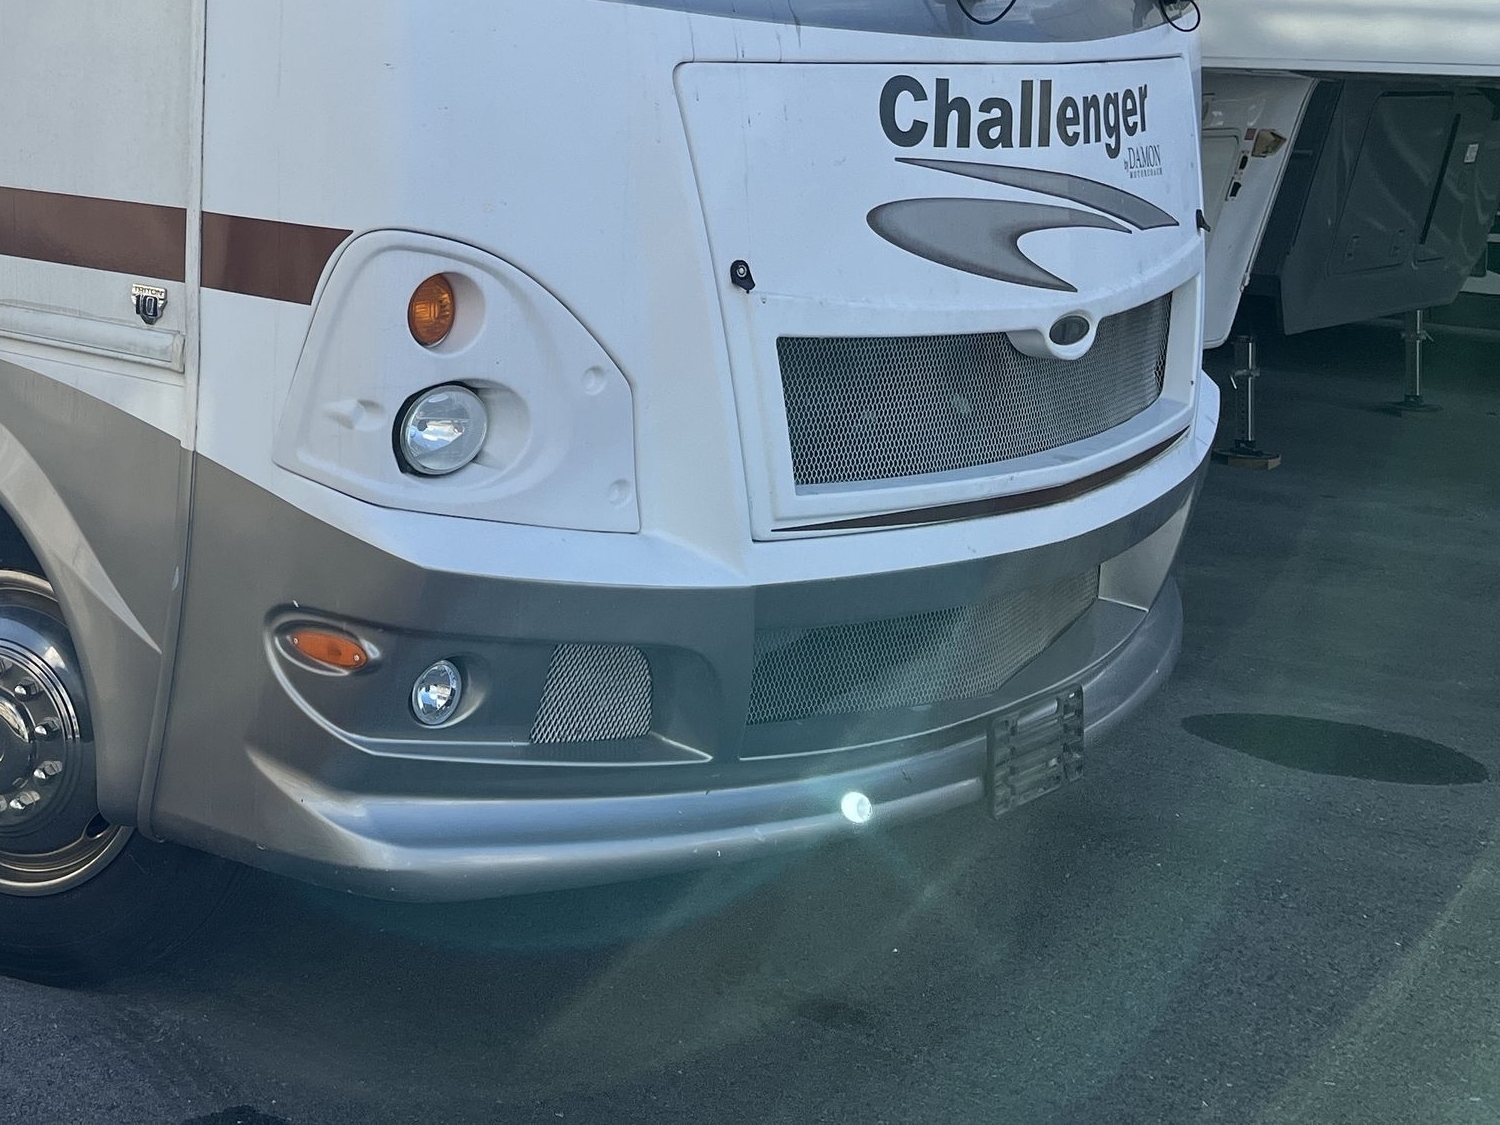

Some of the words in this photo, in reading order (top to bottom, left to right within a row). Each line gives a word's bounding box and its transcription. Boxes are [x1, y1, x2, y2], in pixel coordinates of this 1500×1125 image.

[879, 74, 1148, 159] Challenger
[1128, 145, 1160, 169] DAMON
[134, 286, 165, 296] TRITON
